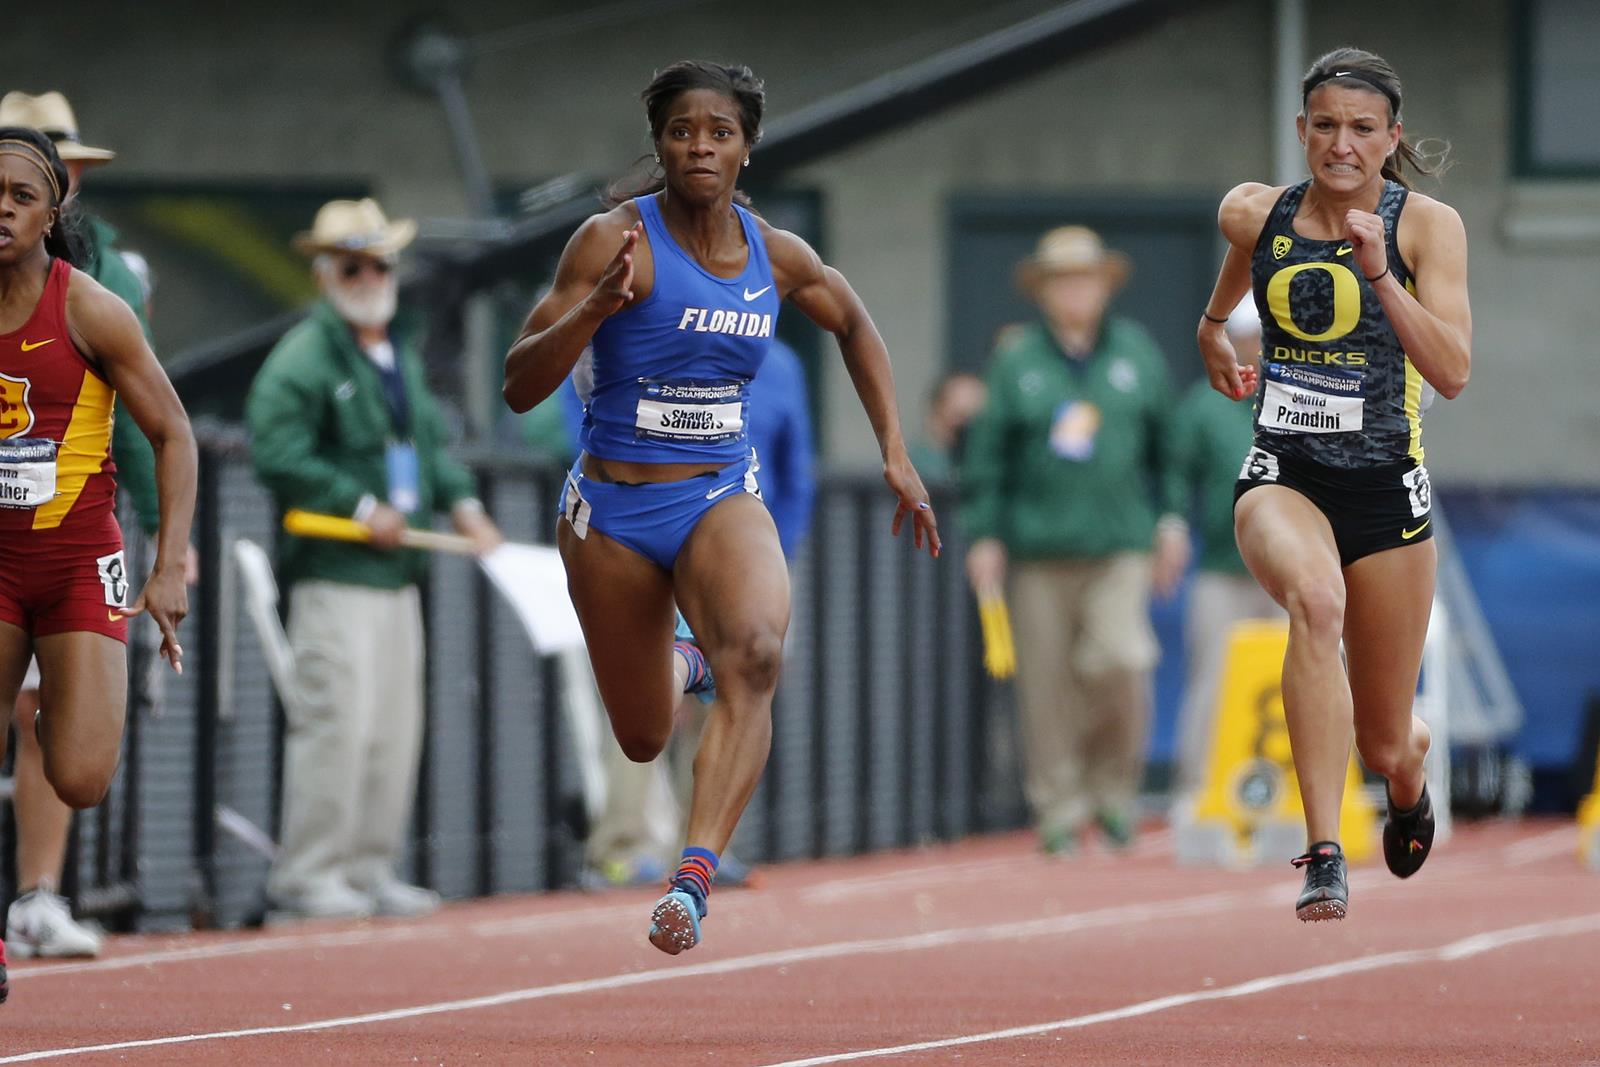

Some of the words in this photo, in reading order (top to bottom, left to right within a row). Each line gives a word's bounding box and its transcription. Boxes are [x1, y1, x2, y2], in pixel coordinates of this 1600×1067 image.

[1267, 262, 1360, 342] O
[677, 307, 771, 337] FLORIDA
[1274, 347, 1365, 365] DUCKS
[1292, 372, 1360, 392] CHAMPIONSHIPS
[675, 389, 737, 399] CHAMPIONSHIPS
[1276, 405, 1340, 430] Prandini
